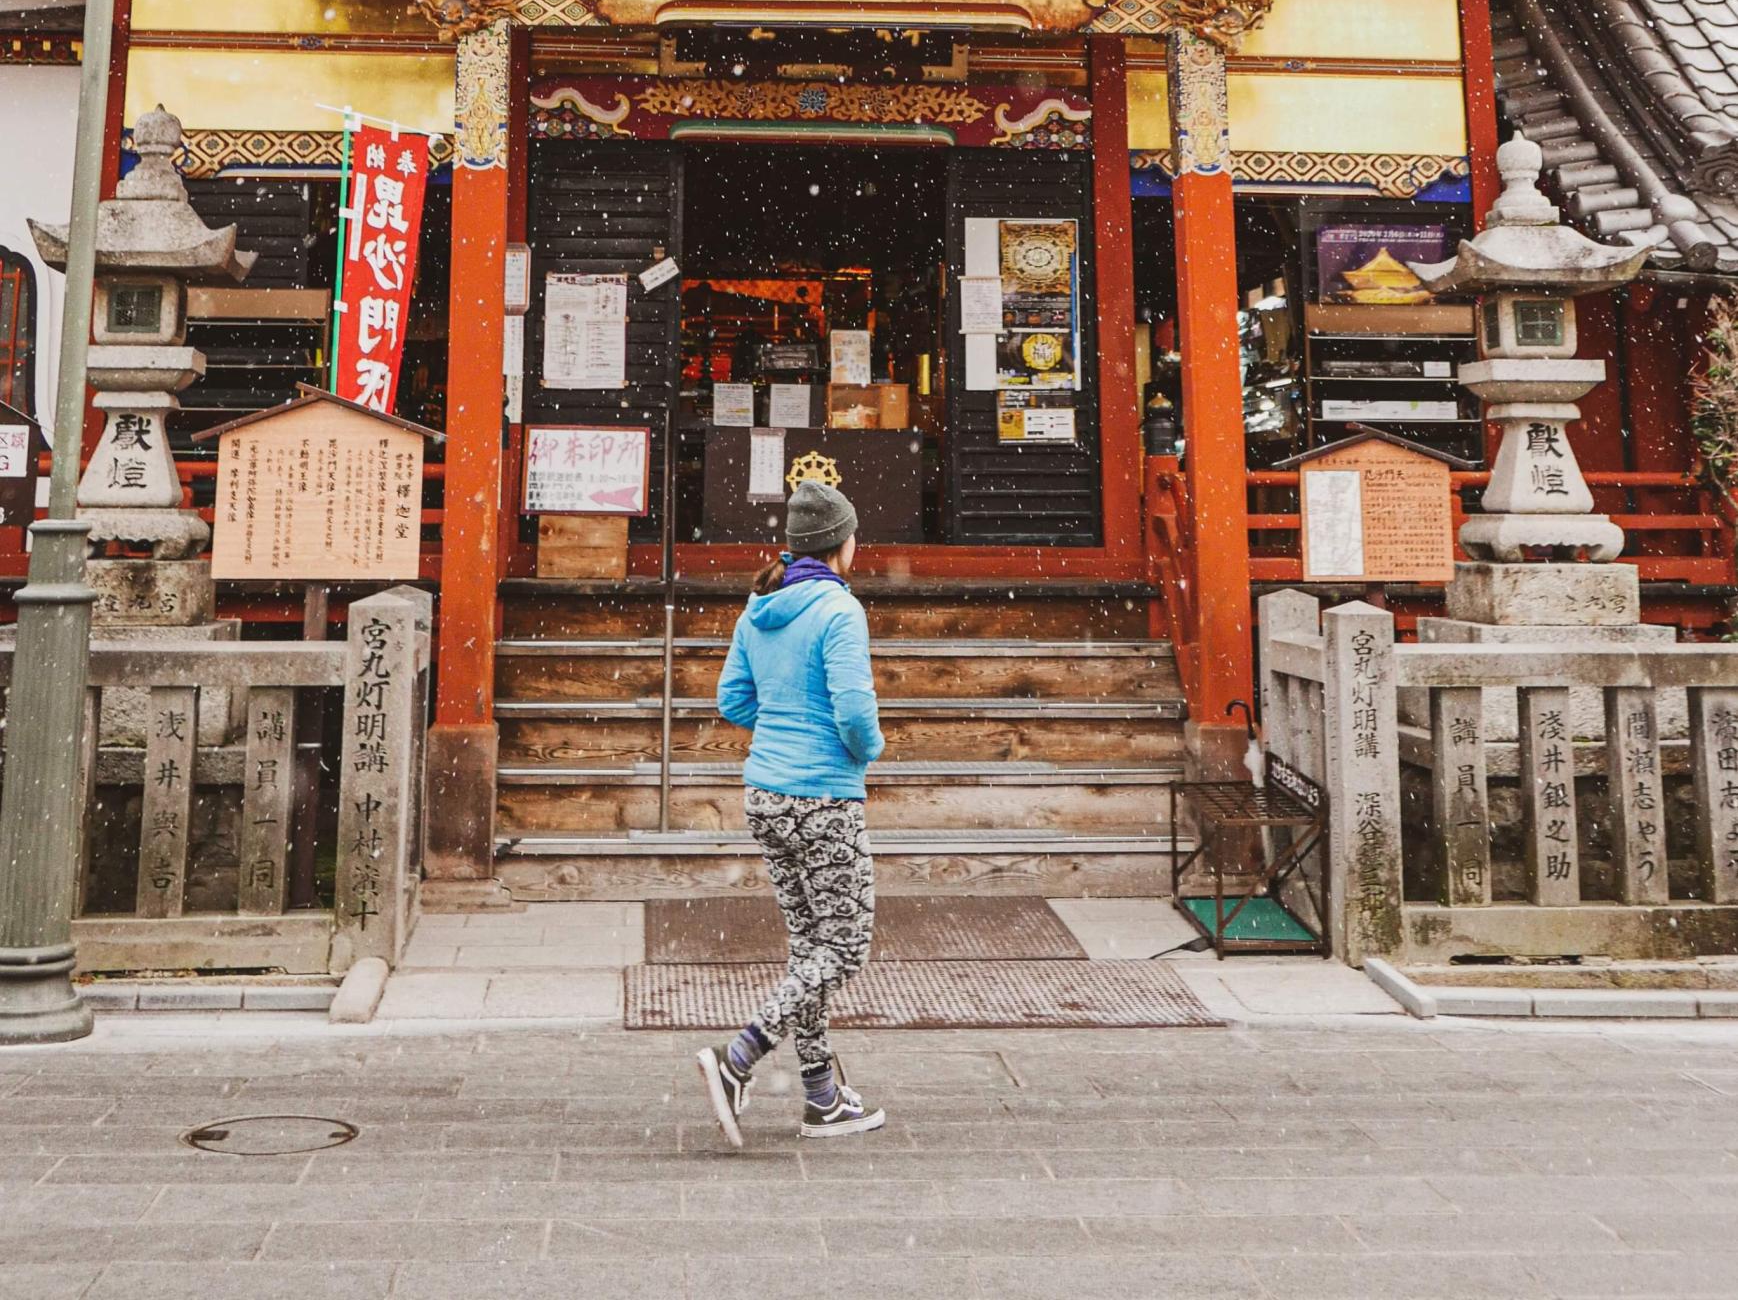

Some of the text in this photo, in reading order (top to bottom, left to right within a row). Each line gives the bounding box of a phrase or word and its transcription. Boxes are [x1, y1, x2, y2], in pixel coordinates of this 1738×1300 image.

[248, 710, 287, 889] 講員一同
[1450, 717, 1482, 886] 講員一同
